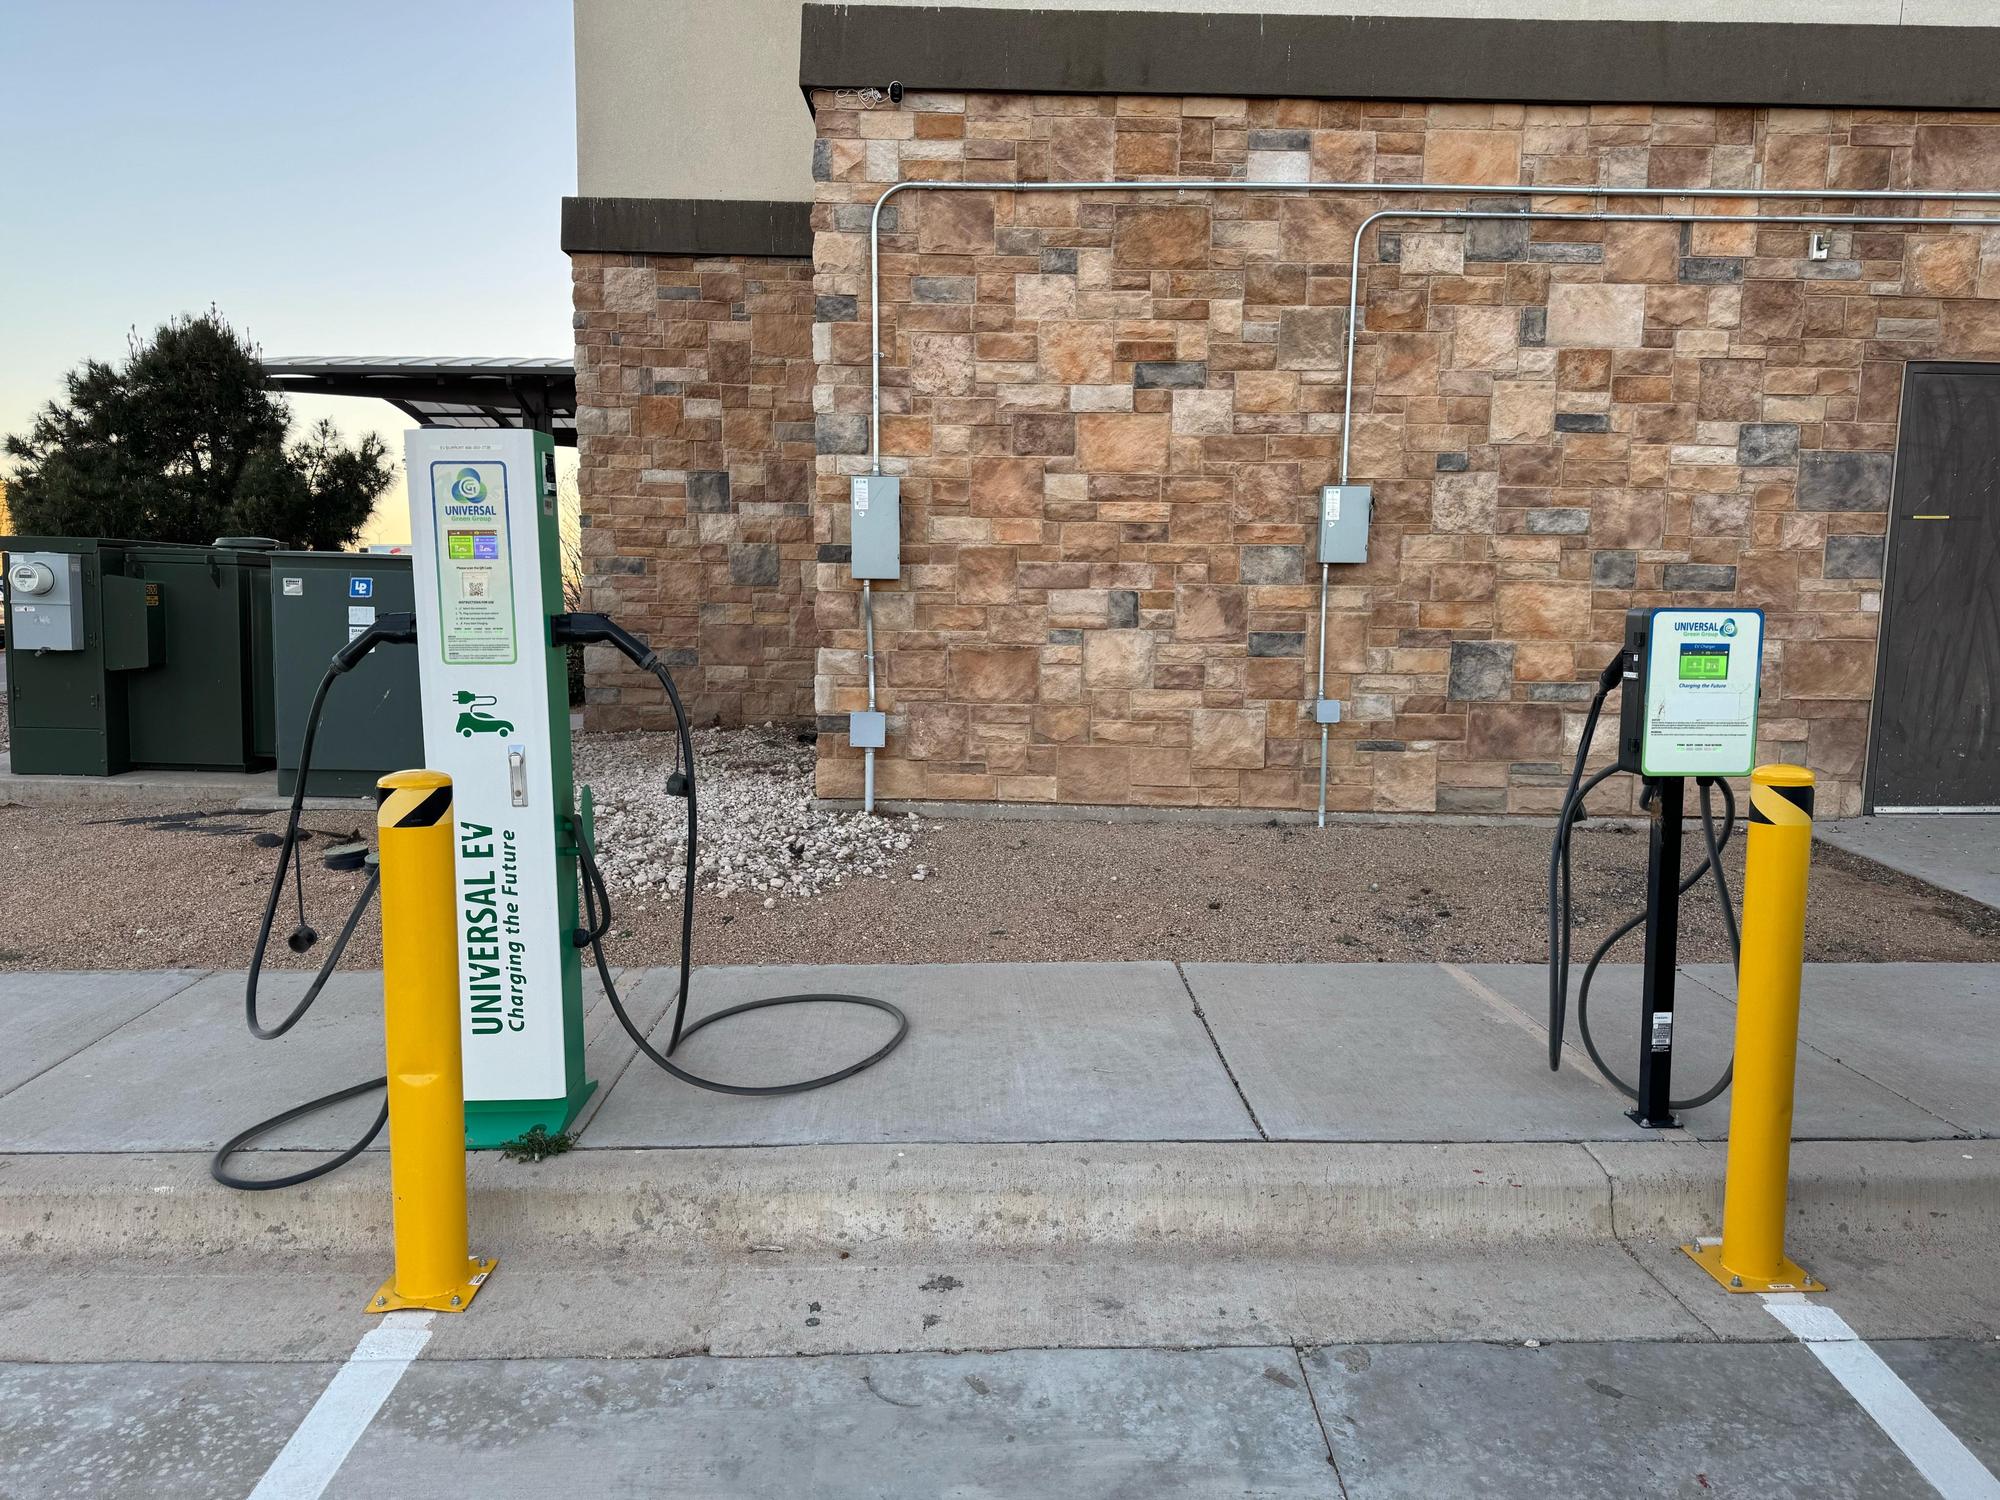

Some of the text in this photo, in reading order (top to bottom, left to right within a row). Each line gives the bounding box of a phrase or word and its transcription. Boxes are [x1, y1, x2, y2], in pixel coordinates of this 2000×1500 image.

[445, 505, 496, 516] UNIVERSAL
[1674, 622, 1719, 632] UNIVERSAL
[460, 821, 504, 1035] UNIVERSAL EV
[501, 829, 527, 1032] Charging the Future
